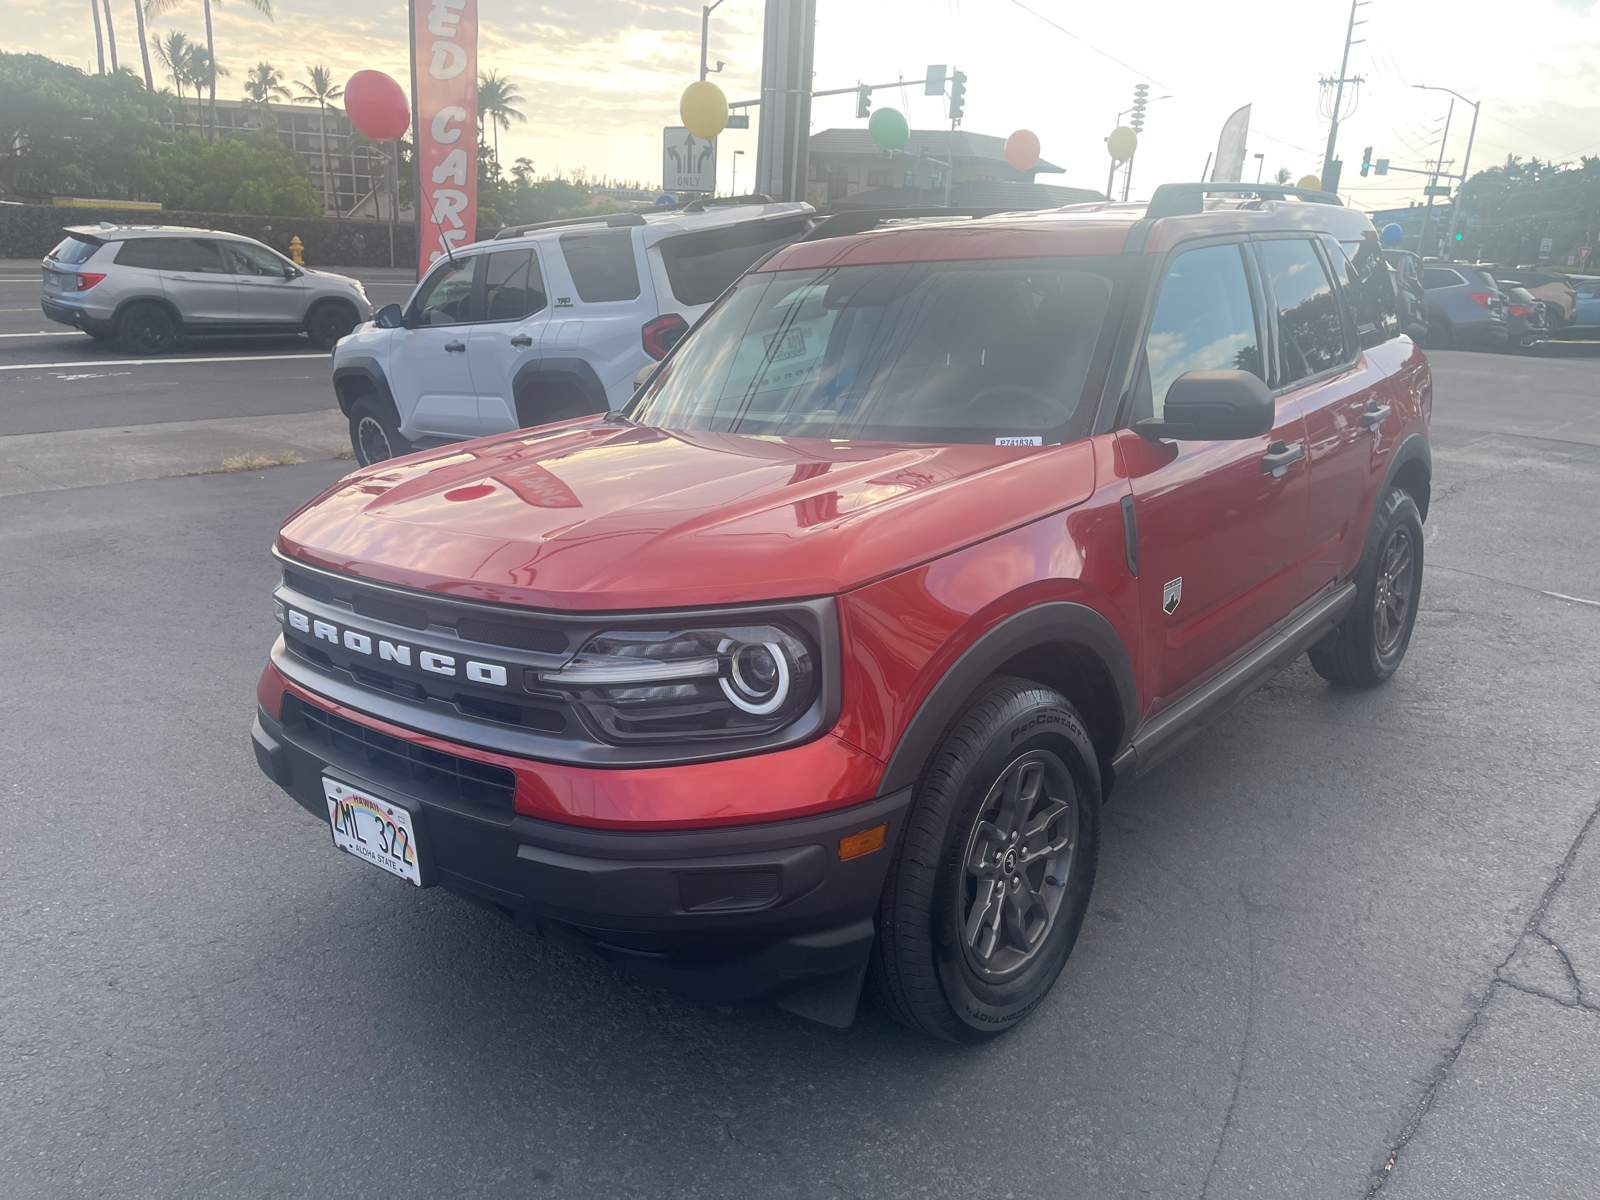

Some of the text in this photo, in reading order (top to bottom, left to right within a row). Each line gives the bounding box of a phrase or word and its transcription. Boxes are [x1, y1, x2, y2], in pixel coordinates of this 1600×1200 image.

[677, 176, 701, 187] ONLY
[288, 609, 508, 687] BRONCO
[352, 794, 380, 813] HAWAII
[328, 795, 413, 867] ZML 322
[355, 844, 398, 871] ALOHA STATE
